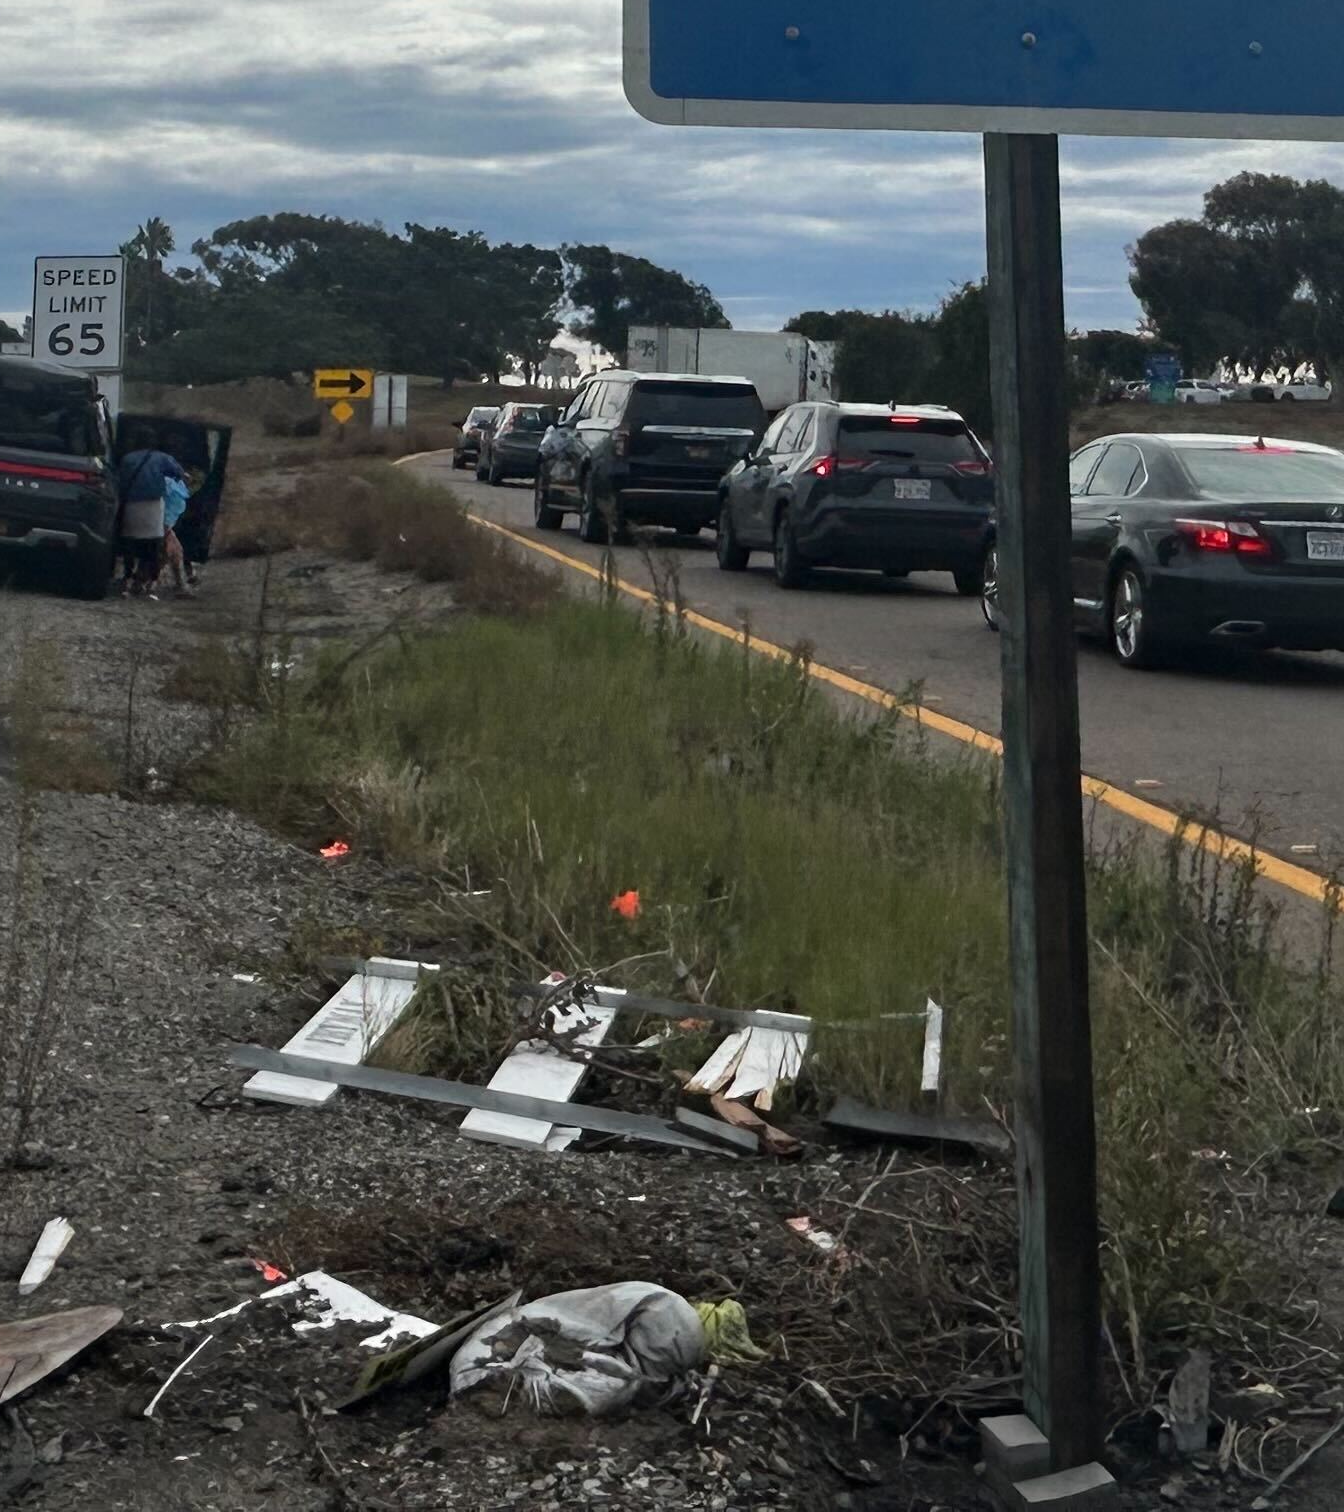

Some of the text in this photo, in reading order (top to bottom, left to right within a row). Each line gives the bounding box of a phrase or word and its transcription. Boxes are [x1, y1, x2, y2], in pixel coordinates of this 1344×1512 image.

[43, 269, 116, 286] SPEED
[49, 296, 107, 313] LIMIT
[48, 323, 105, 356] 65
